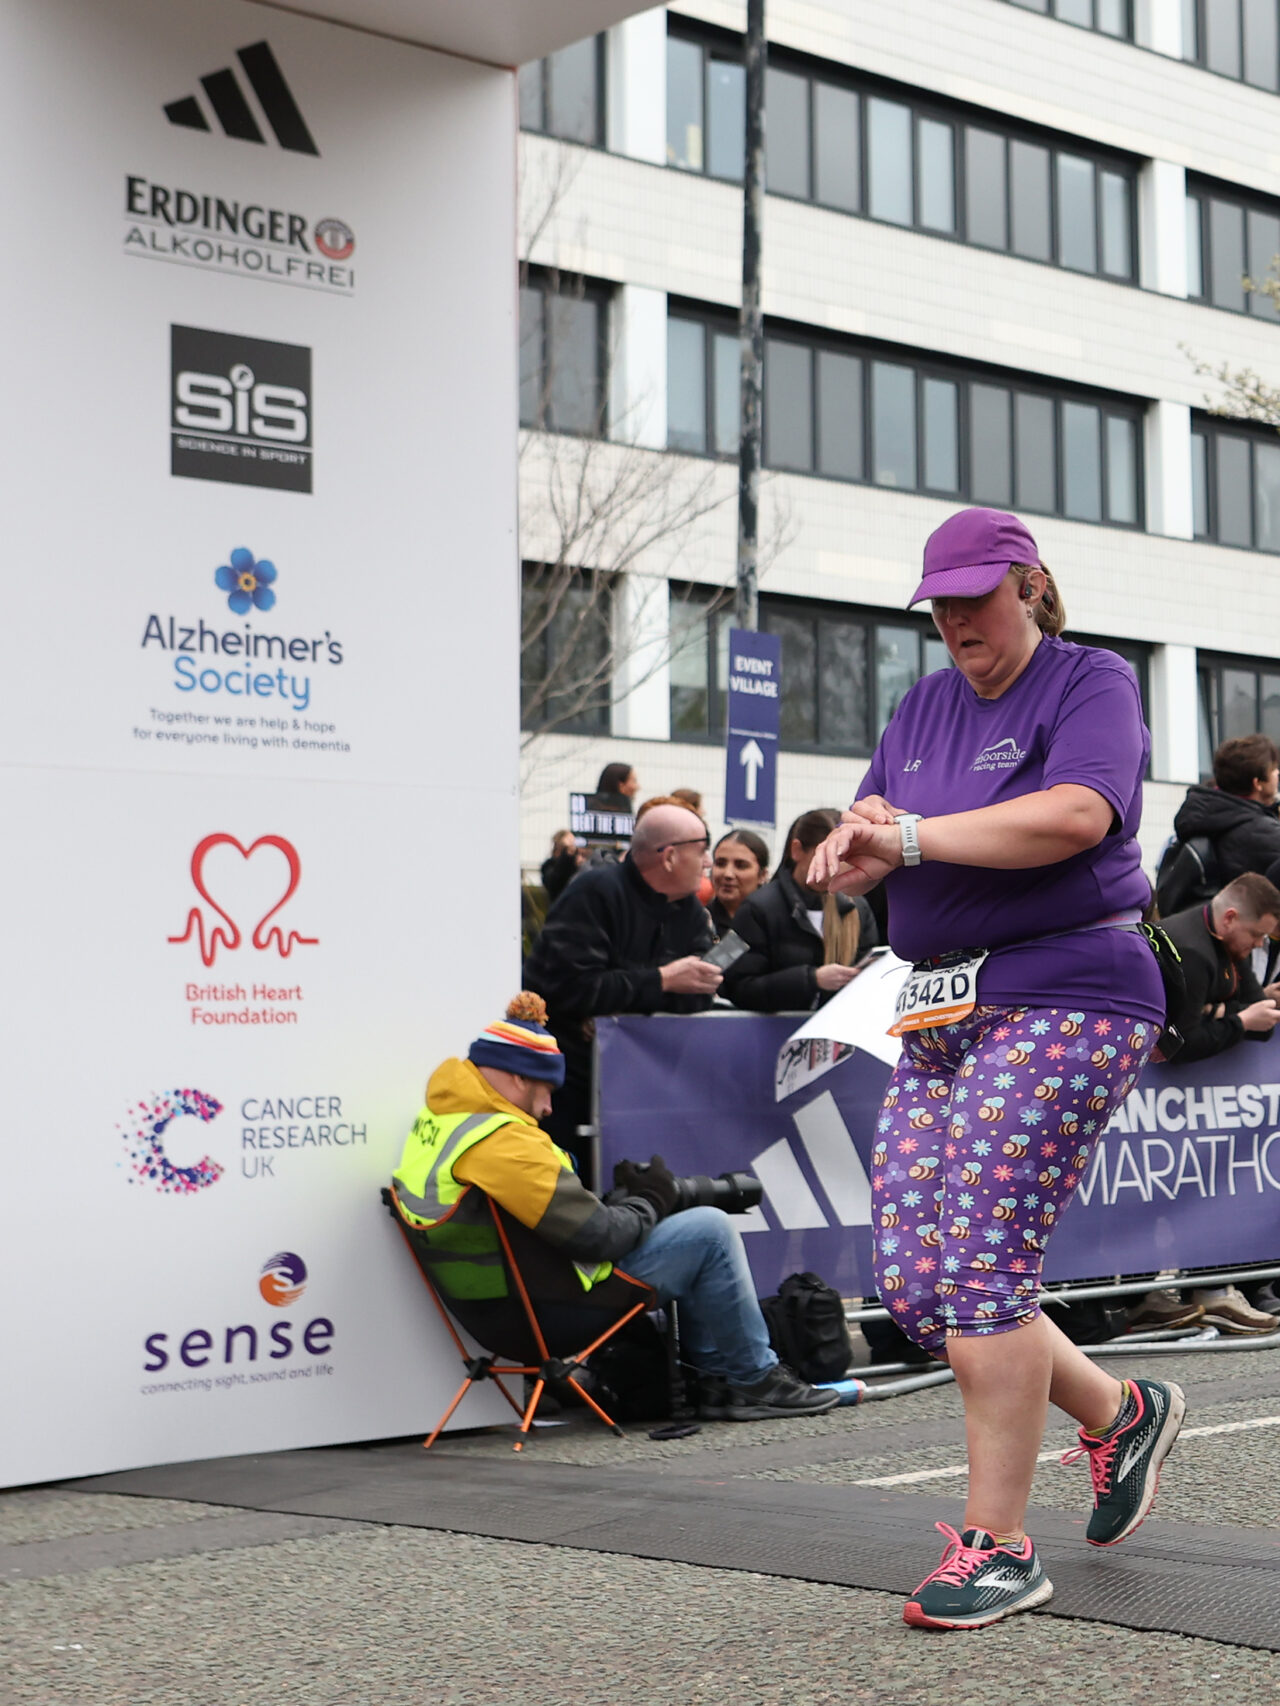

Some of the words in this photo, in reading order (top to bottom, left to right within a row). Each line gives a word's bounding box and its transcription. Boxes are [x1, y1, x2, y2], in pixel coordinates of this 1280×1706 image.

[125, 174, 310, 254] ERDINGER
[123, 226, 355, 288] ALKOHOLFREI
[177, 438, 239, 456] SCIENCE
[241, 446, 257, 459] IN
[259, 451, 308, 465] SPORT
[140, 613, 344, 665] Alzheimer's
[734, 655, 774, 676] EVENT
[173, 656, 311, 711] Society
[730, 675, 778, 698] VILLAGE
[150, 708, 211, 727] Together
[213, 714, 233, 727] we
[236, 716, 257, 729] are
[260, 715, 289, 732] help
[292, 718, 301, 731] &
[304, 718, 337, 735] hope
[132, 727, 153, 742] for
[155, 729, 220, 745] everyone
[223, 733, 259, 749] living
[261, 734, 289, 749] with
[292, 736, 351, 752] dementia
[185, 984, 247, 1001] British
[253, 984, 304, 1002] Heart
[950, 973, 969, 1000] D
[190, 1008, 299, 1025] Foundation
[241, 1096, 343, 1121] CANCER
[242, 1124, 368, 1150] RESEARCH
[241, 1156, 275, 1179] UK
[144, 1316, 336, 1373] sense
[140, 1377, 213, 1396] connecting
[249, 1369, 287, 1385] sound
[289, 1365, 312, 1379] and
[315, 1363, 334, 1376] life
